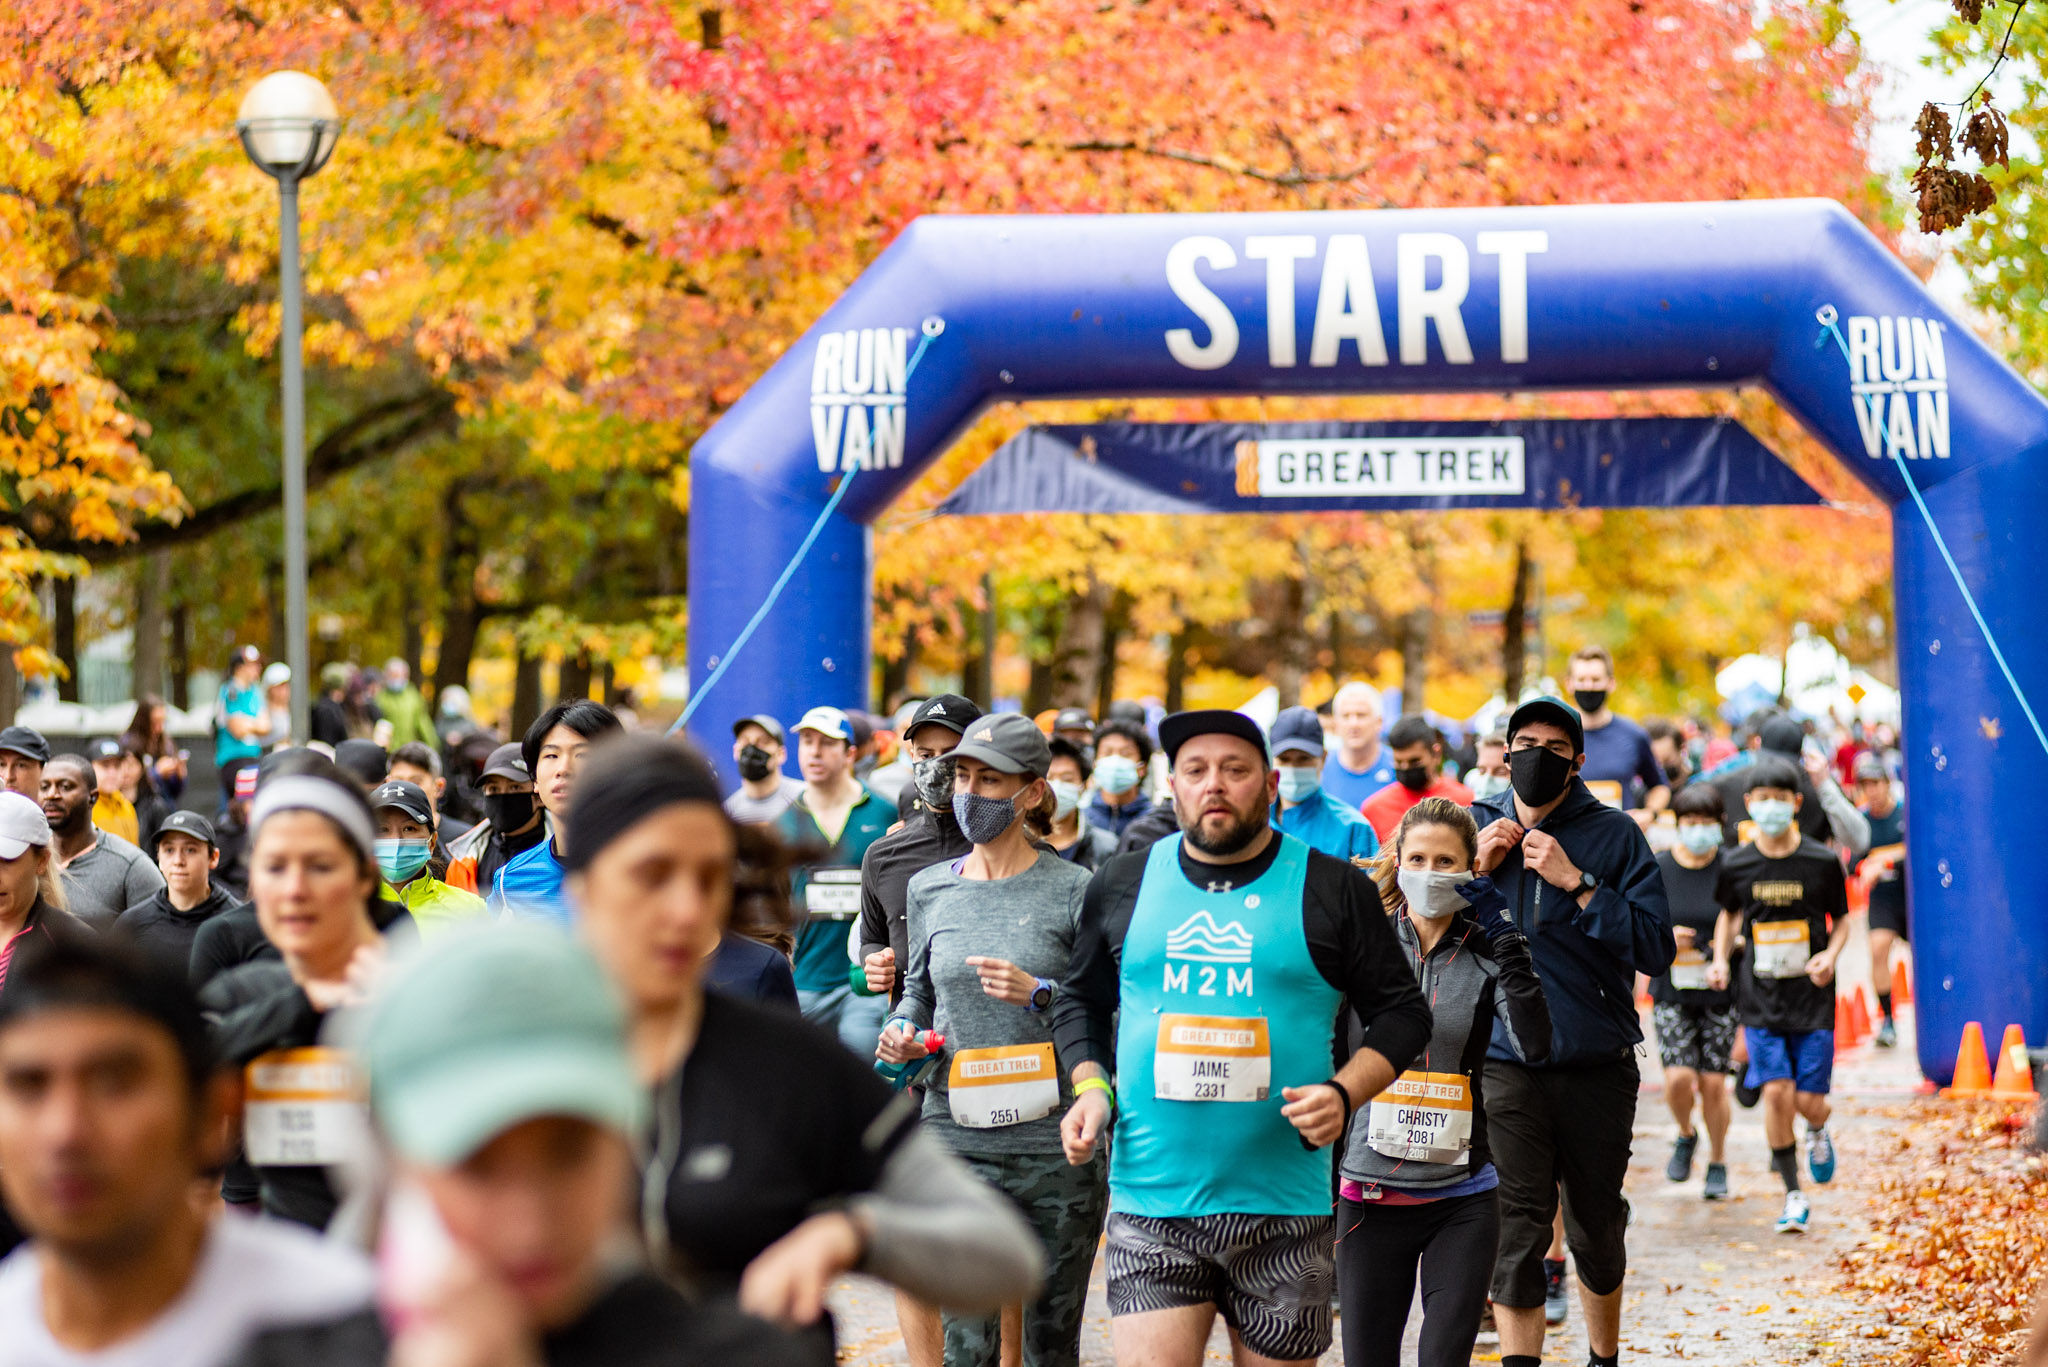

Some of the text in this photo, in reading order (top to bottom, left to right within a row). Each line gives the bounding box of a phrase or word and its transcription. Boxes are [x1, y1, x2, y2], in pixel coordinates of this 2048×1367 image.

[1164, 231, 1549, 371] START
[1848, 316, 1948, 383] RUN
[811, 328, 907, 395] RUN
[1851, 391, 1951, 460] VAN
[810, 404, 907, 473] VAN
[1277, 449, 1510, 484] GREAT TREK
[1181, 1030, 1252, 1045] GREAT TREK
[970, 1058, 1037, 1075] GREAT TREK
[1192, 1061, 1231, 1078] JAIME
[1194, 1083, 1225, 1098] 2331
[1396, 1082, 1461, 1098] GREAT TREK
[990, 1108, 1020, 1125] 2551
[1397, 1109, 1448, 1128] CHRISTY
[1407, 1129, 1435, 1145] 2081
[1408, 1148, 1430, 1160] 2081
